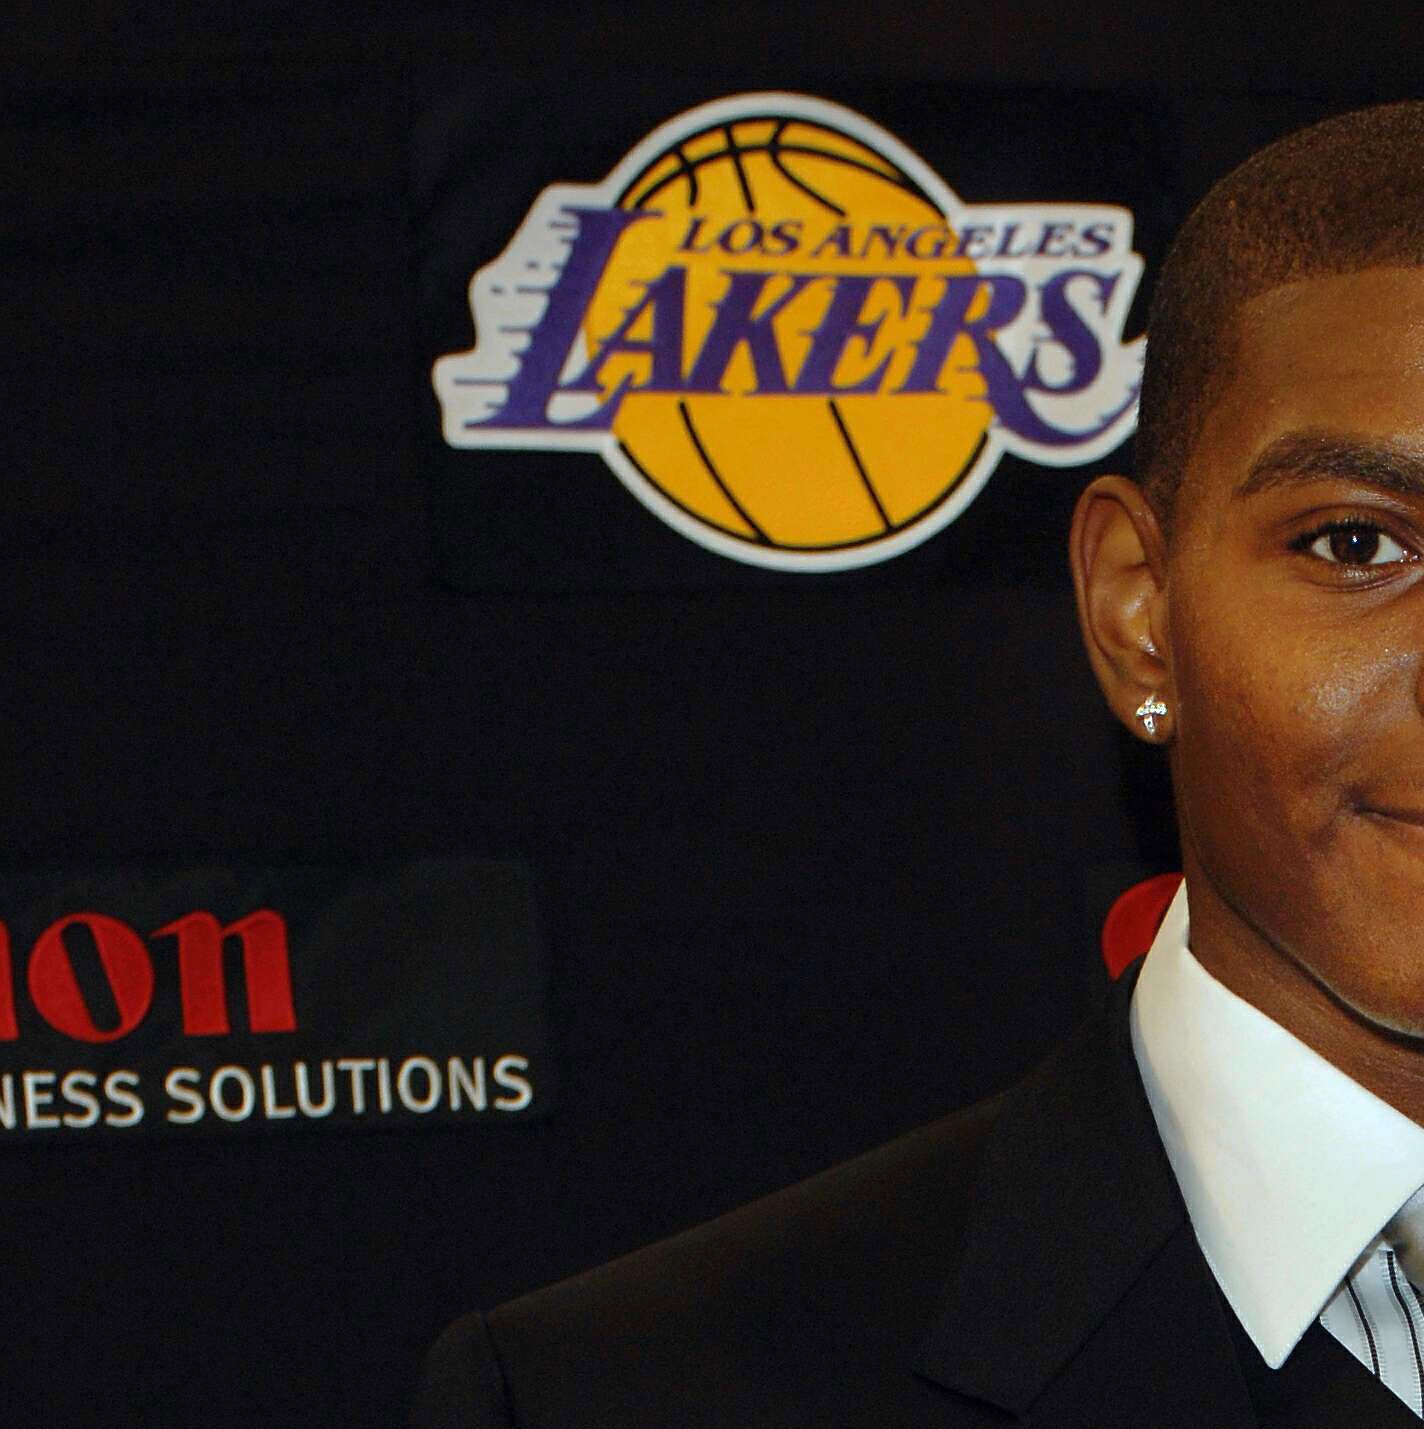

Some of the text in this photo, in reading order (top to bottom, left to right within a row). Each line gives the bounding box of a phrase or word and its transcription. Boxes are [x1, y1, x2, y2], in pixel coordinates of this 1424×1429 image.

[679, 216, 1116, 258] LOS ANGELES
[452, 208, 1140, 447] LAKERS
[0, 908, 297, 1044] on
[165, 1055, 533, 1123] SOLUTIONS
